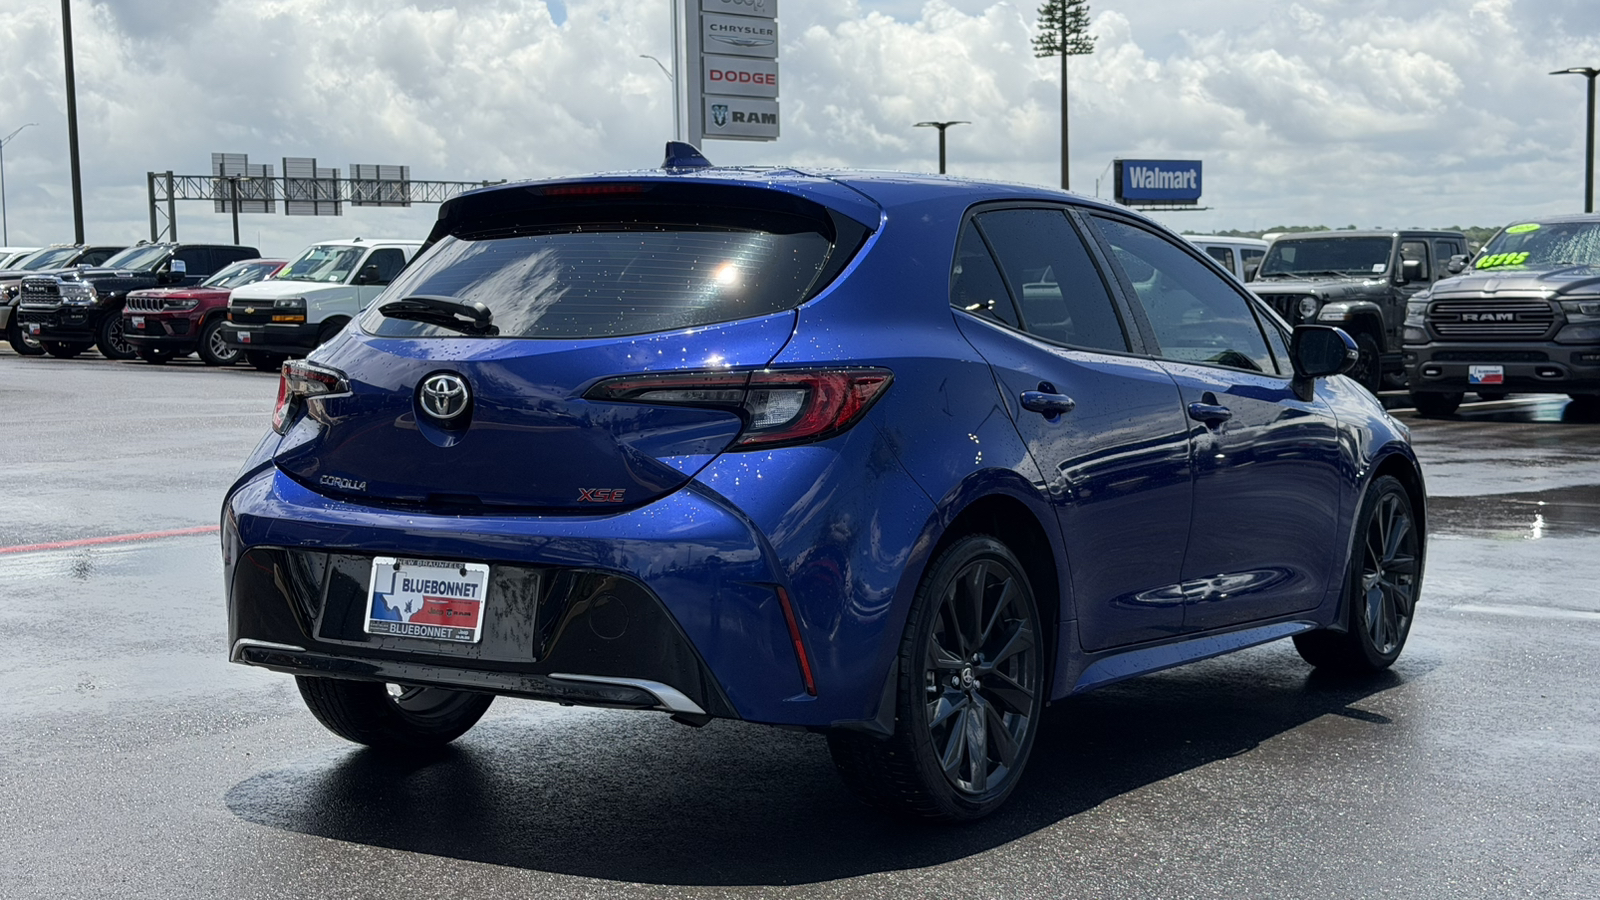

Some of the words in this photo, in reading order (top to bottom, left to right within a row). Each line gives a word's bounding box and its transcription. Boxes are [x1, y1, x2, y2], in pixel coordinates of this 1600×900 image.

[709, 24, 774, 36] CHRYSLER
[709, 69, 776, 86] DODGE
[731, 111, 777, 125] RAM
[1129, 166, 1197, 190] Walmart
[1462, 313, 1513, 321] RAM
[320, 474, 367, 492] COROLLA
[577, 487, 627, 503] XSE
[402, 578, 478, 597] BLUEBONNET
[389, 623, 453, 638] BLUEBONNET
